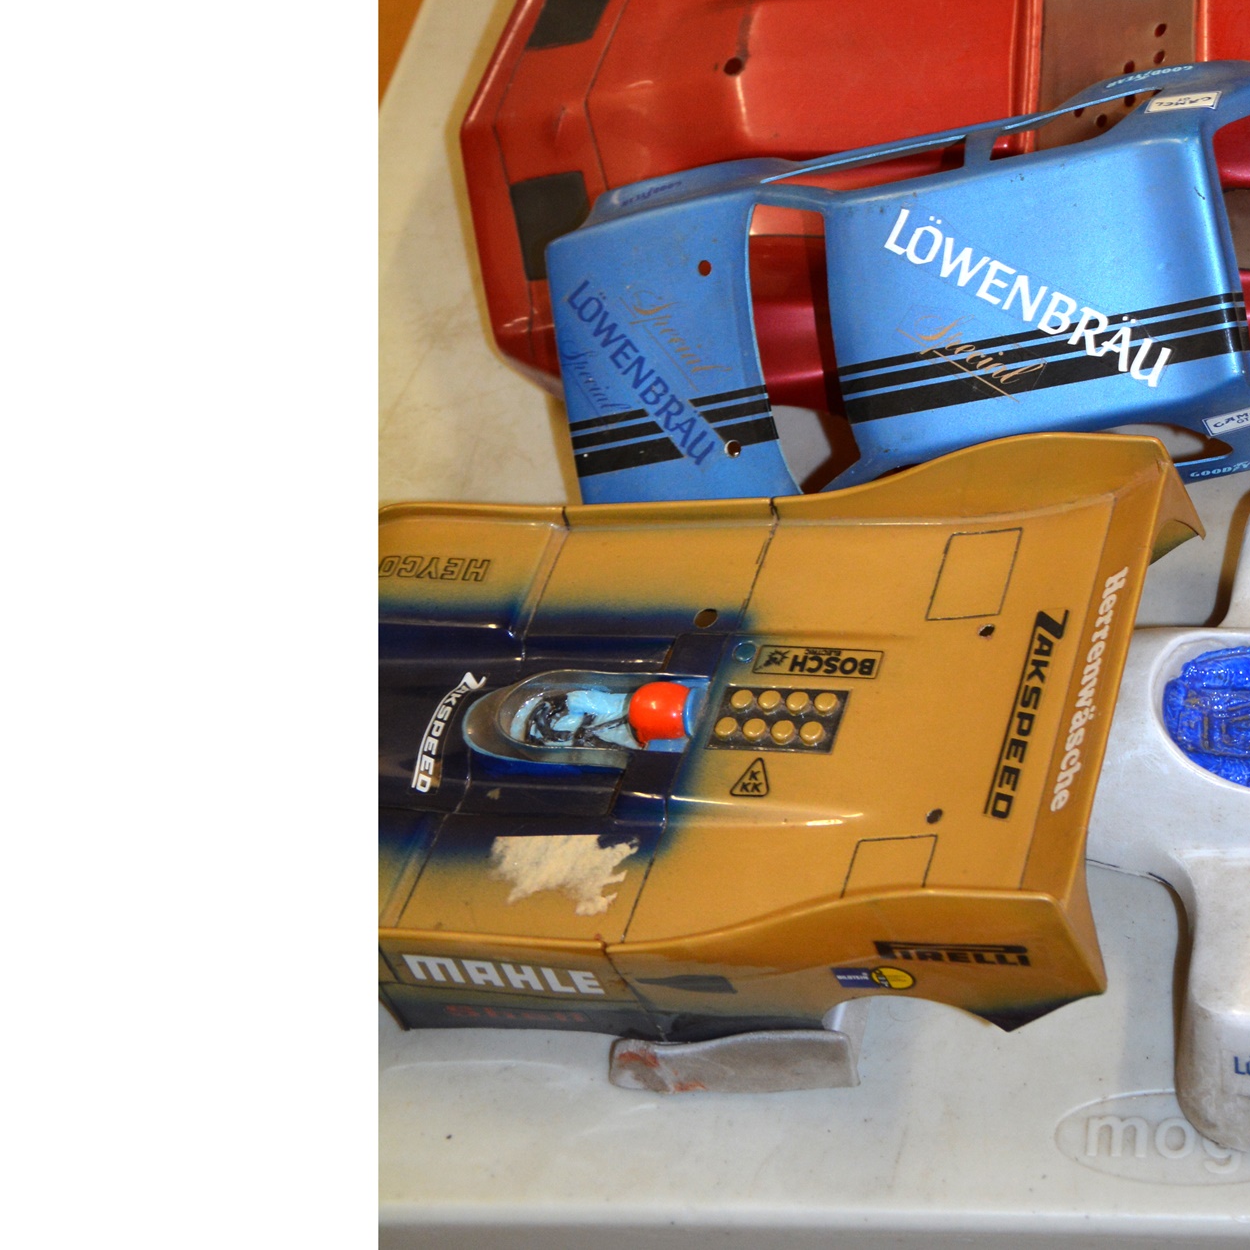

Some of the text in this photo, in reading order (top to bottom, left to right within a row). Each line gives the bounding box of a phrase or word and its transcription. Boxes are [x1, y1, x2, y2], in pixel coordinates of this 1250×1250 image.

[1106, 65, 1194, 88] GOODYEAR
[884, 208, 1172, 388] LÖWENBRÄU
[568, 280, 716, 466] LÖWENBRÄU
[378, 555, 491, 582] HEYCO
[789, 654, 876, 676] BOSCH
[1050, 566, 1129, 812] Herrenwäsche
[412, 672, 487, 793] ZAKSPEED
[983, 609, 1069, 820] ZAKSPEED
[402, 954, 605, 995] MAHLE
[873, 940, 1031, 967] PIRELLI
